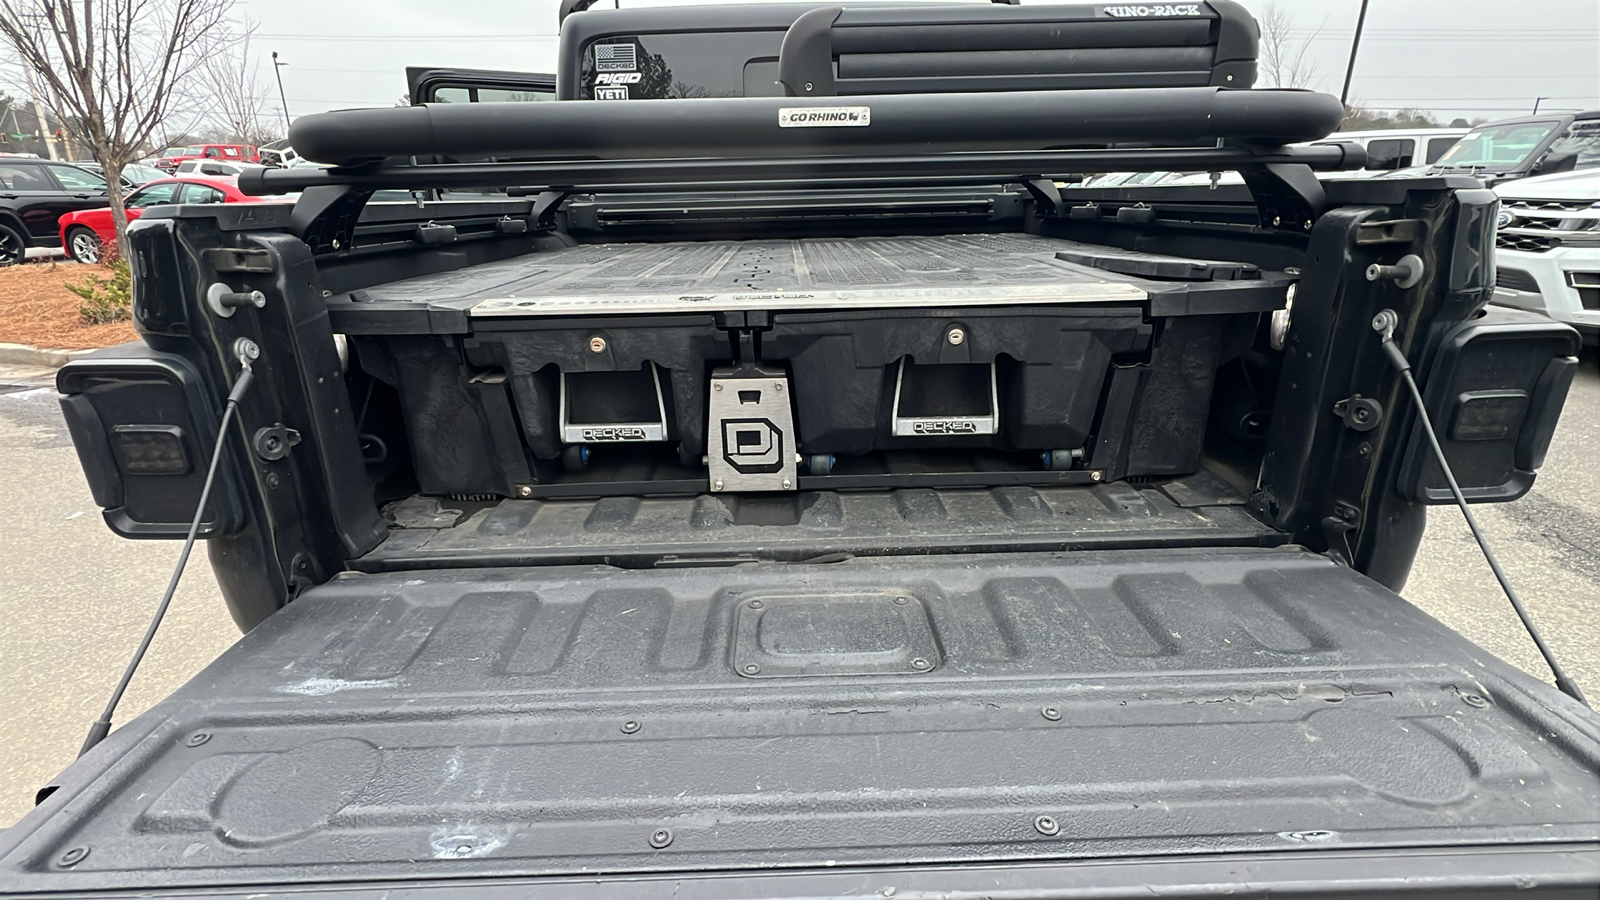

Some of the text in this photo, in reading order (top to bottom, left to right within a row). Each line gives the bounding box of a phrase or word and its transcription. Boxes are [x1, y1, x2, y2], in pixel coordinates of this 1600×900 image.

[1103, 5, 1200, 17] HINO-RACK
[595, 72, 642, 84] RIGID
[597, 89, 626, 100] YETI
[913, 421, 976, 433] DECKED
[583, 428, 646, 440] DECKED
